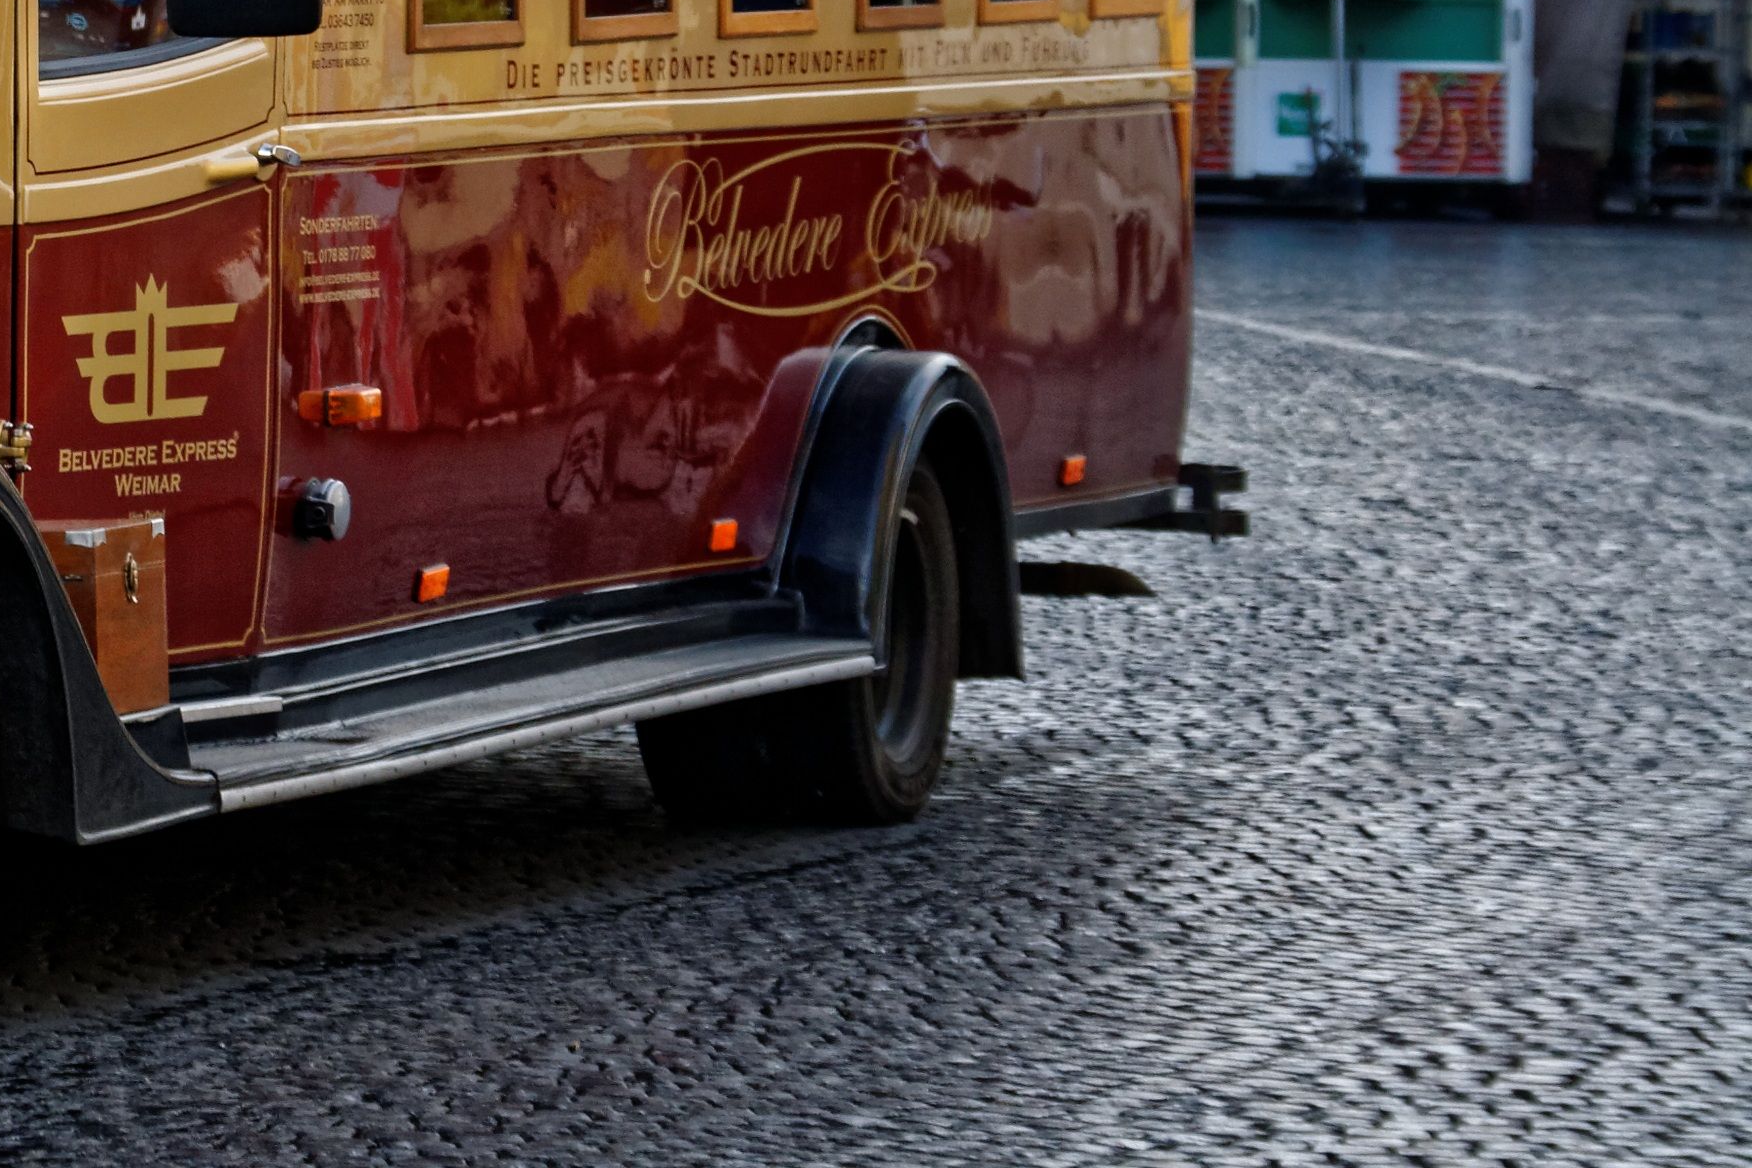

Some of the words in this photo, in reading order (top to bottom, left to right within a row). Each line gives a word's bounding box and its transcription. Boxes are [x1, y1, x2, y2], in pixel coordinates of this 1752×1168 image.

[506, 59, 541, 90] DIE
[555, 47, 717, 88] PREISGEKRÖNTE
[728, 48, 889, 78] STADTRUNDFAHRT
[644, 156, 844, 302] Belvedere
[58, 444, 158, 473] BELVEDERE
[161, 437, 237, 465] EXPRESS
[114, 472, 181, 498] WEIMAR
